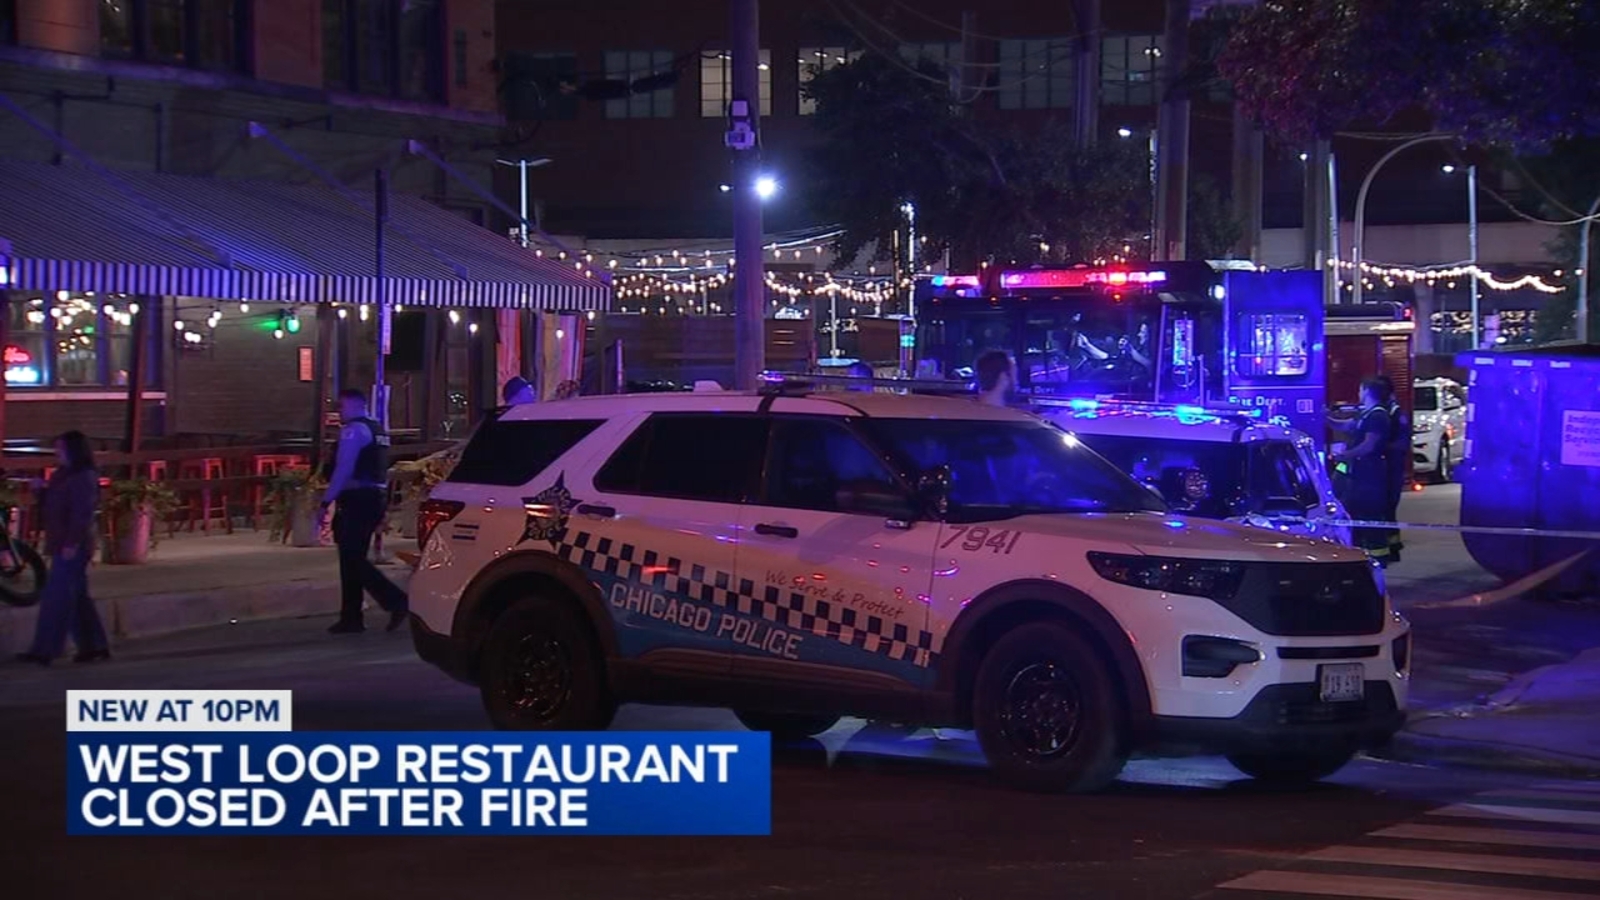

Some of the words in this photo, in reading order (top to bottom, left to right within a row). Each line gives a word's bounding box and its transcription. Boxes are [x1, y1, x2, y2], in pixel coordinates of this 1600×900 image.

[940, 526, 1021, 554] 7941
[765, 569, 787, 586] We
[788, 576, 828, 598] Serve
[832, 587, 846, 603] &
[850, 592, 905, 620] Protect
[609, 582, 710, 632] CHICAGO
[716, 613, 803, 660] POLICE
